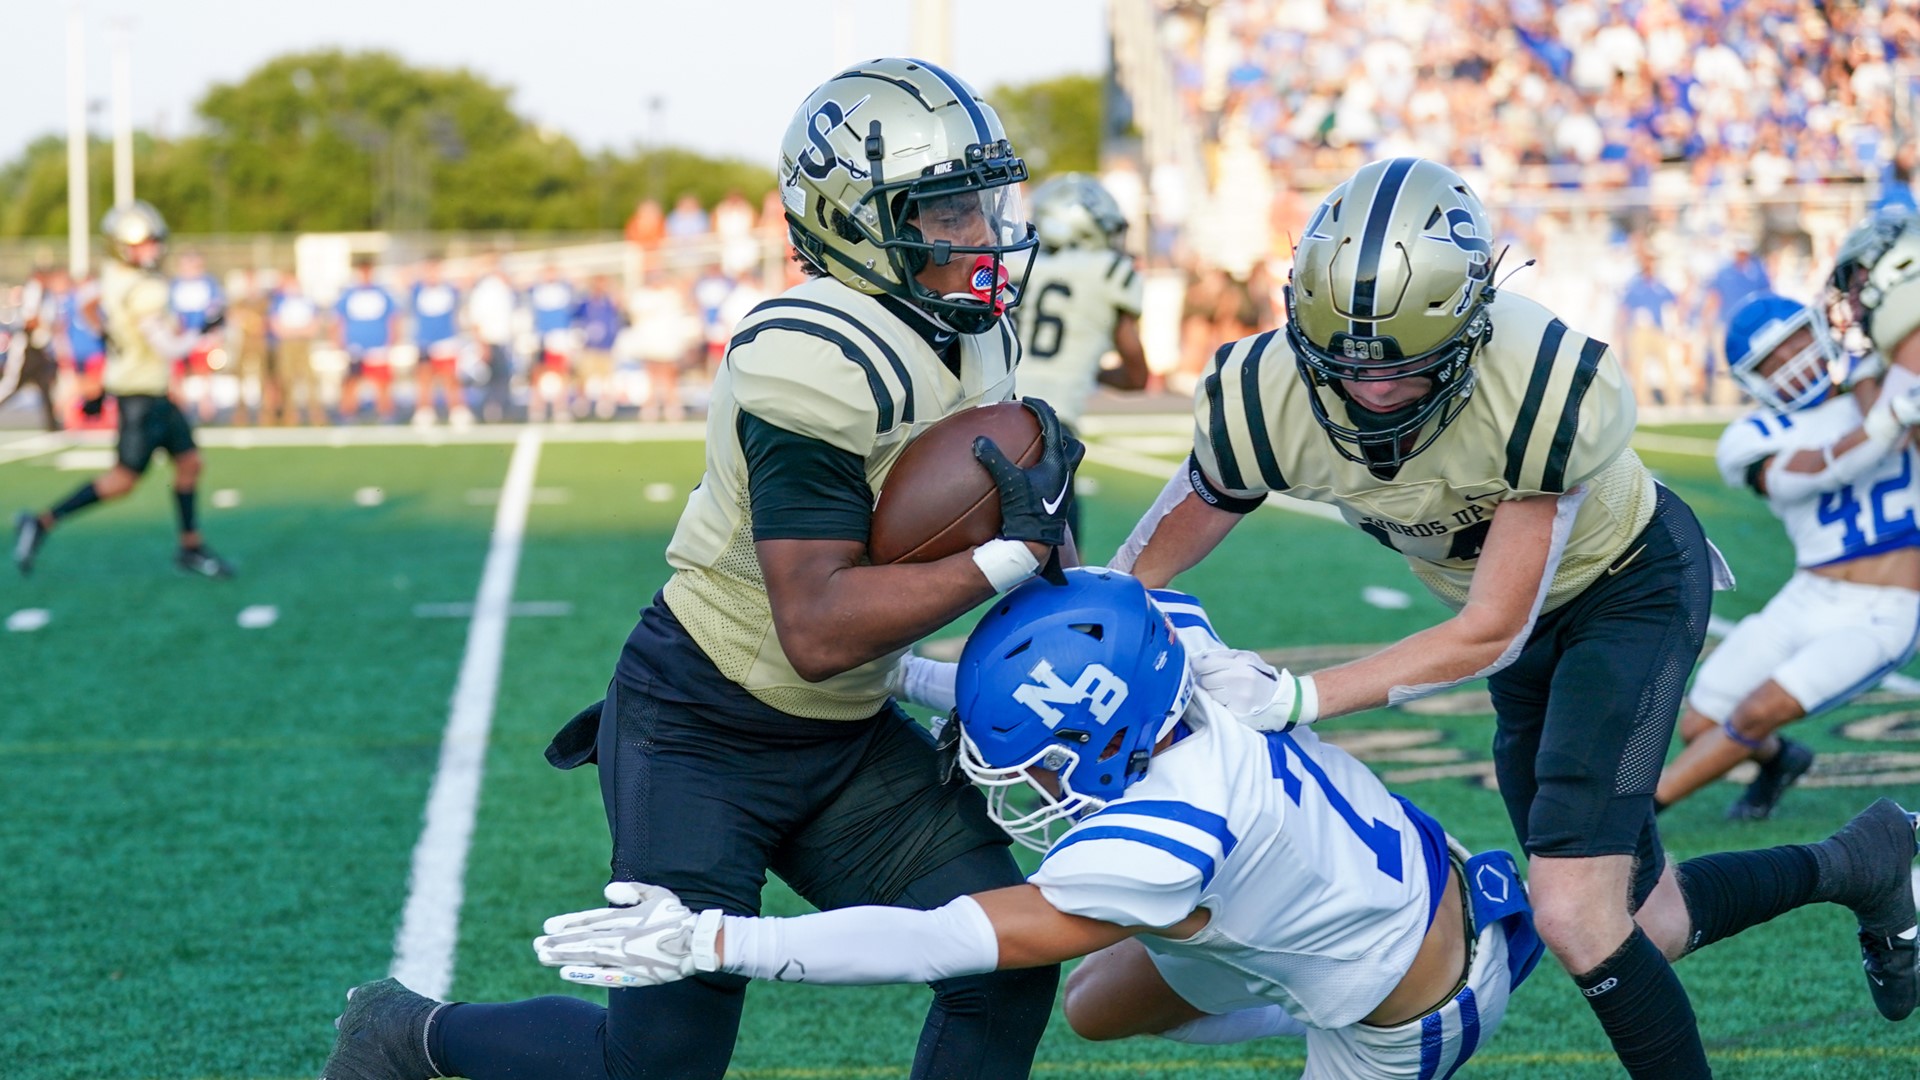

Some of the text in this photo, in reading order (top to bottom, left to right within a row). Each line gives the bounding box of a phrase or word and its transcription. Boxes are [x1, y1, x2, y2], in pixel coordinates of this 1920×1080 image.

[797, 98, 845, 181] S
[933, 161, 953, 175] NIKE
[1343, 339, 1384, 360] 830
[1452, 504, 1484, 525] UP
[1818, 449, 1915, 547] 42
[1011, 659, 1129, 730] NB
[1266, 731, 1404, 883] 7
[600, 974, 637, 983] OOST
